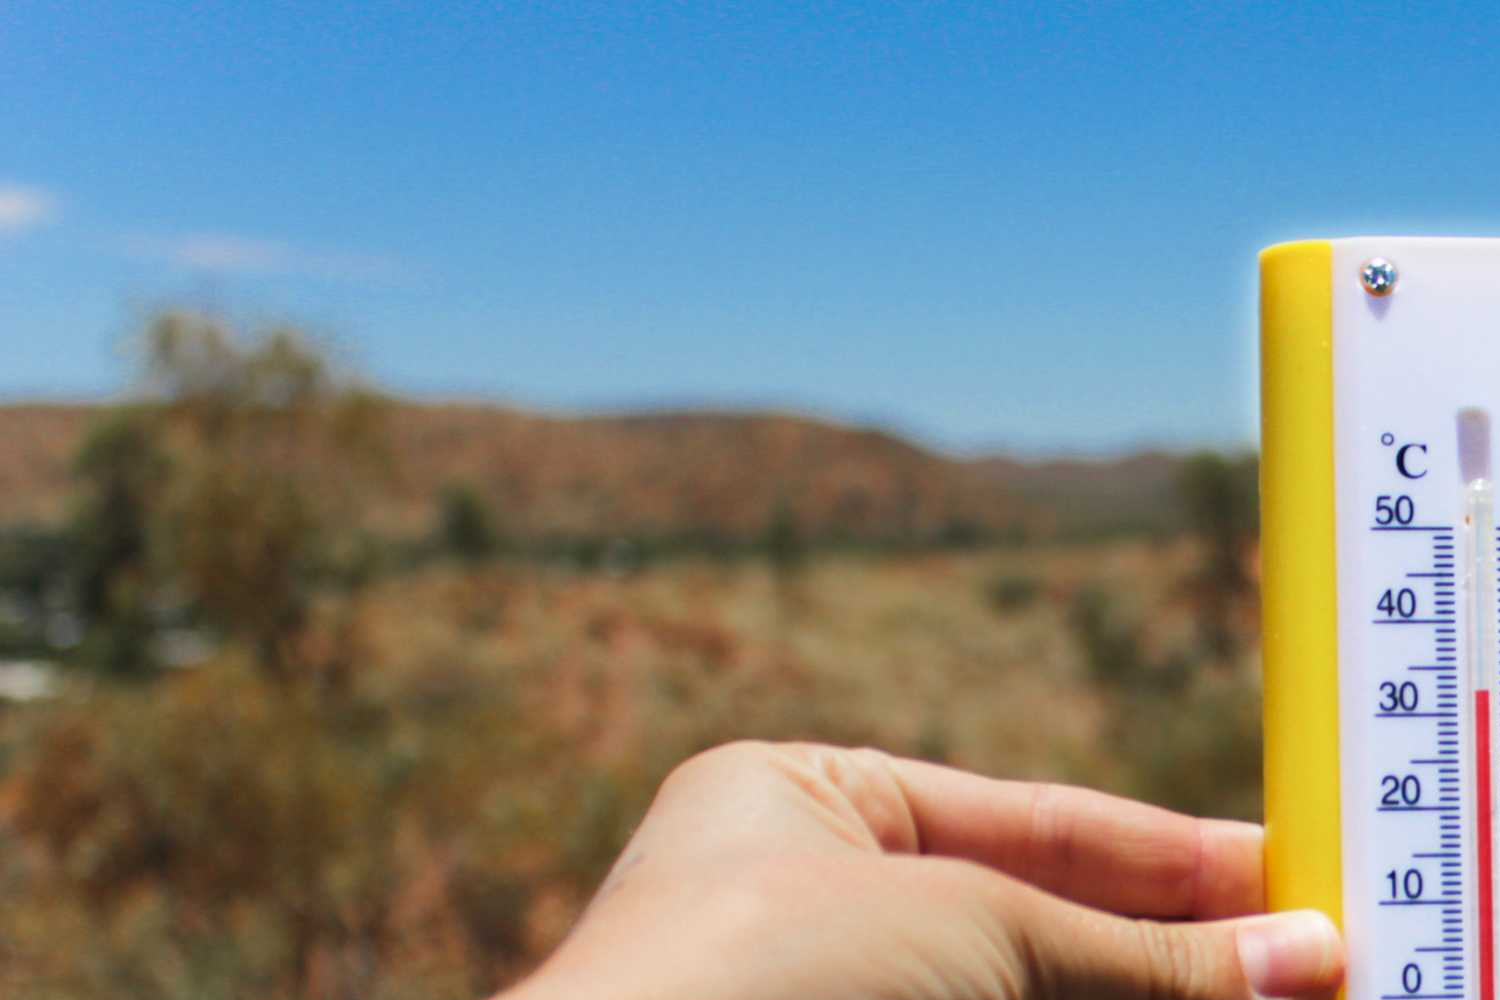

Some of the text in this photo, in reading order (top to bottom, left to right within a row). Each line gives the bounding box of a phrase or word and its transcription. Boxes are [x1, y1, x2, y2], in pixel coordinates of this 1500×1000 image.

[1375, 496, 1414, 525] 50
[1377, 589, 1416, 618] 40
[1379, 682, 1418, 712] 30
[1381, 776, 1420, 805] 20
[1386, 869, 1423, 899] 10
[1402, 963, 1422, 993] 0
